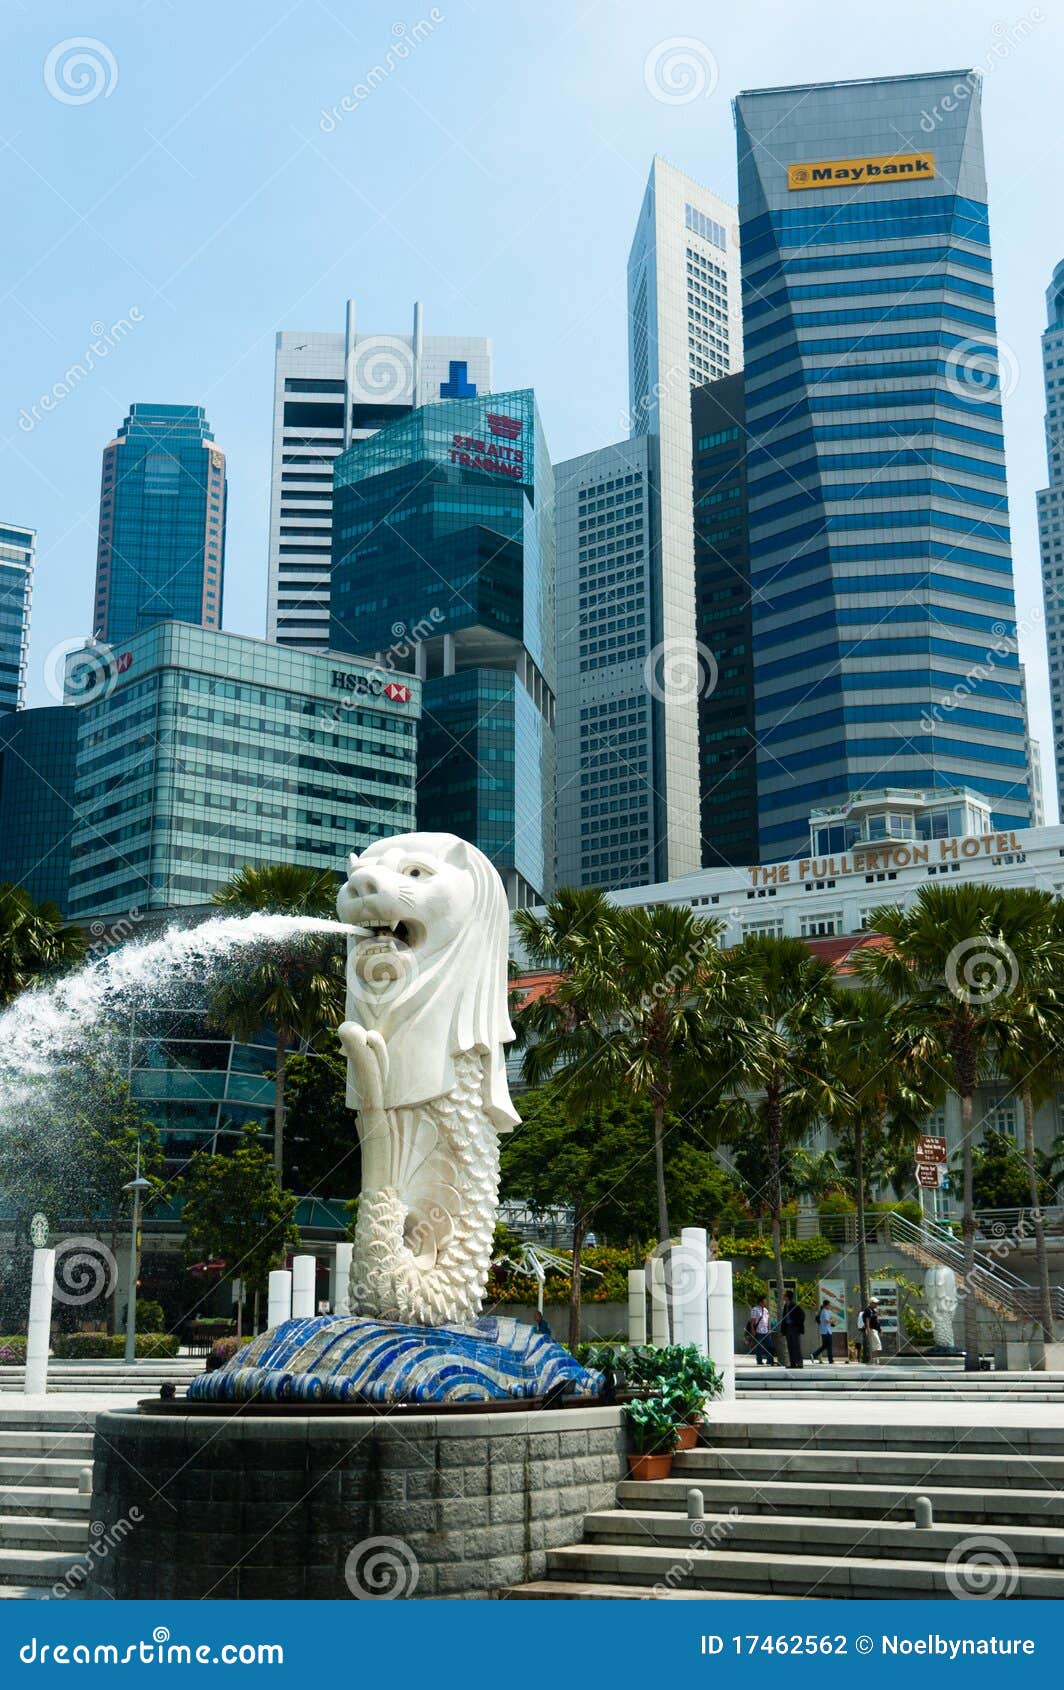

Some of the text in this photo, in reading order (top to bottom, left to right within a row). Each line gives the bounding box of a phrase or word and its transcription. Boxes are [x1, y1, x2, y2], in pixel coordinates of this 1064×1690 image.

[812, 160, 930, 181] Maybank
[452, 434, 524, 462] STRAITS
[448, 449, 523, 479] TRADING
[332, 670, 382, 697] HSBC
[748, 831, 1022, 887] THE FULLERTON HOTEL
